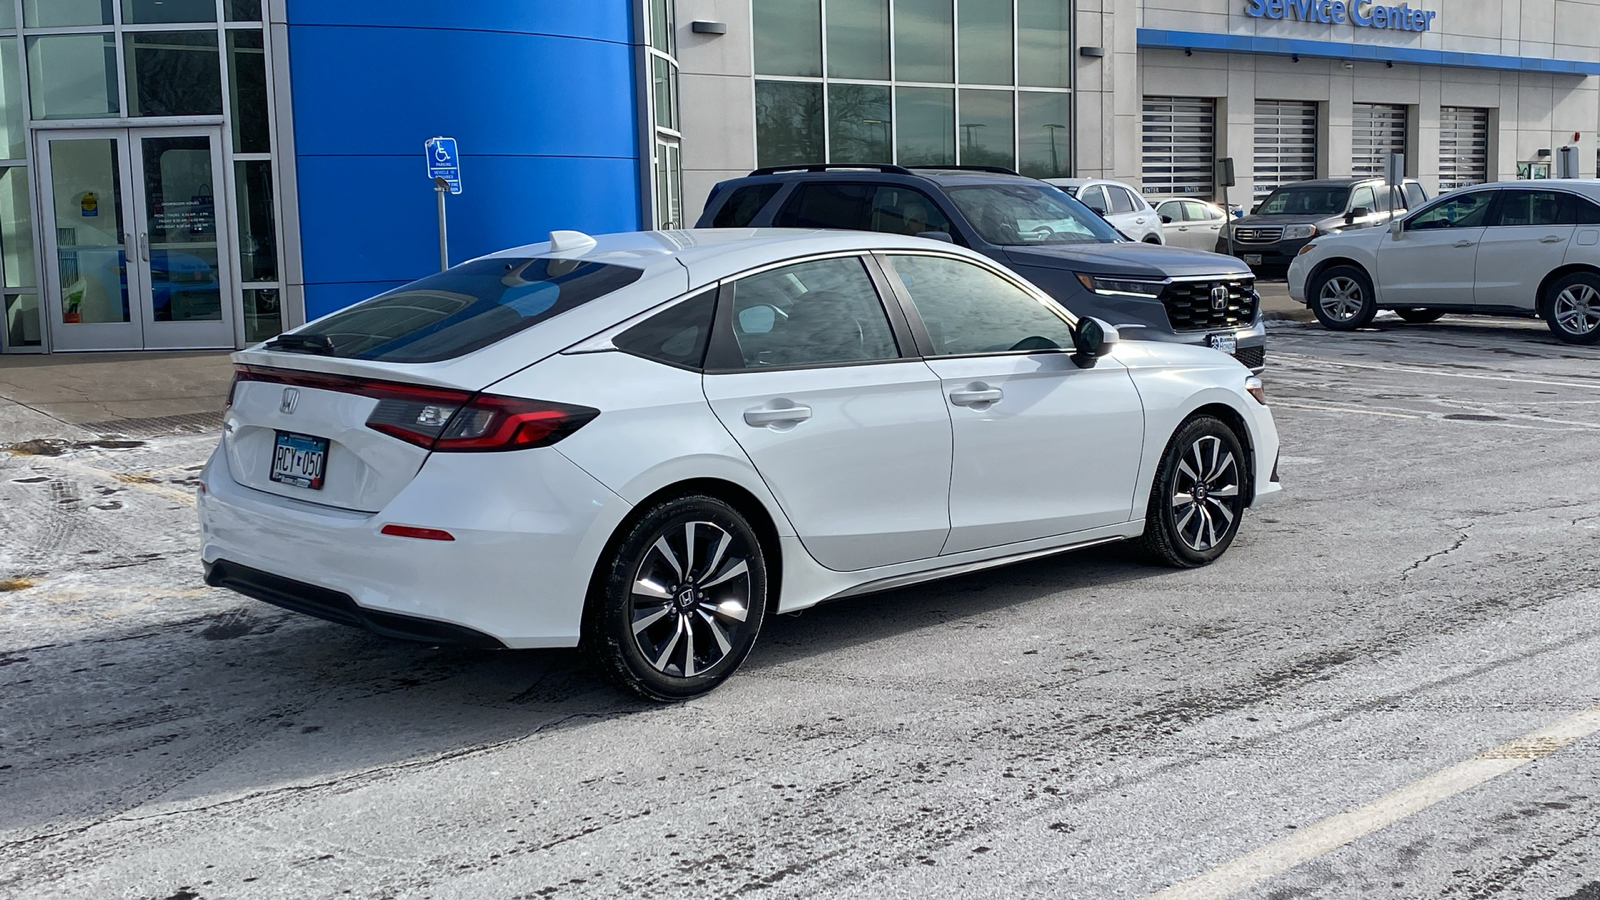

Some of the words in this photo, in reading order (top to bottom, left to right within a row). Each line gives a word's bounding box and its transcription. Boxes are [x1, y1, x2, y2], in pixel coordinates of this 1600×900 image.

[1247, 0, 1345, 23] Service
[1351, 0, 1436, 31] Center
[275, 446, 297, 472] RCY
[302, 451, 321, 477] 050
